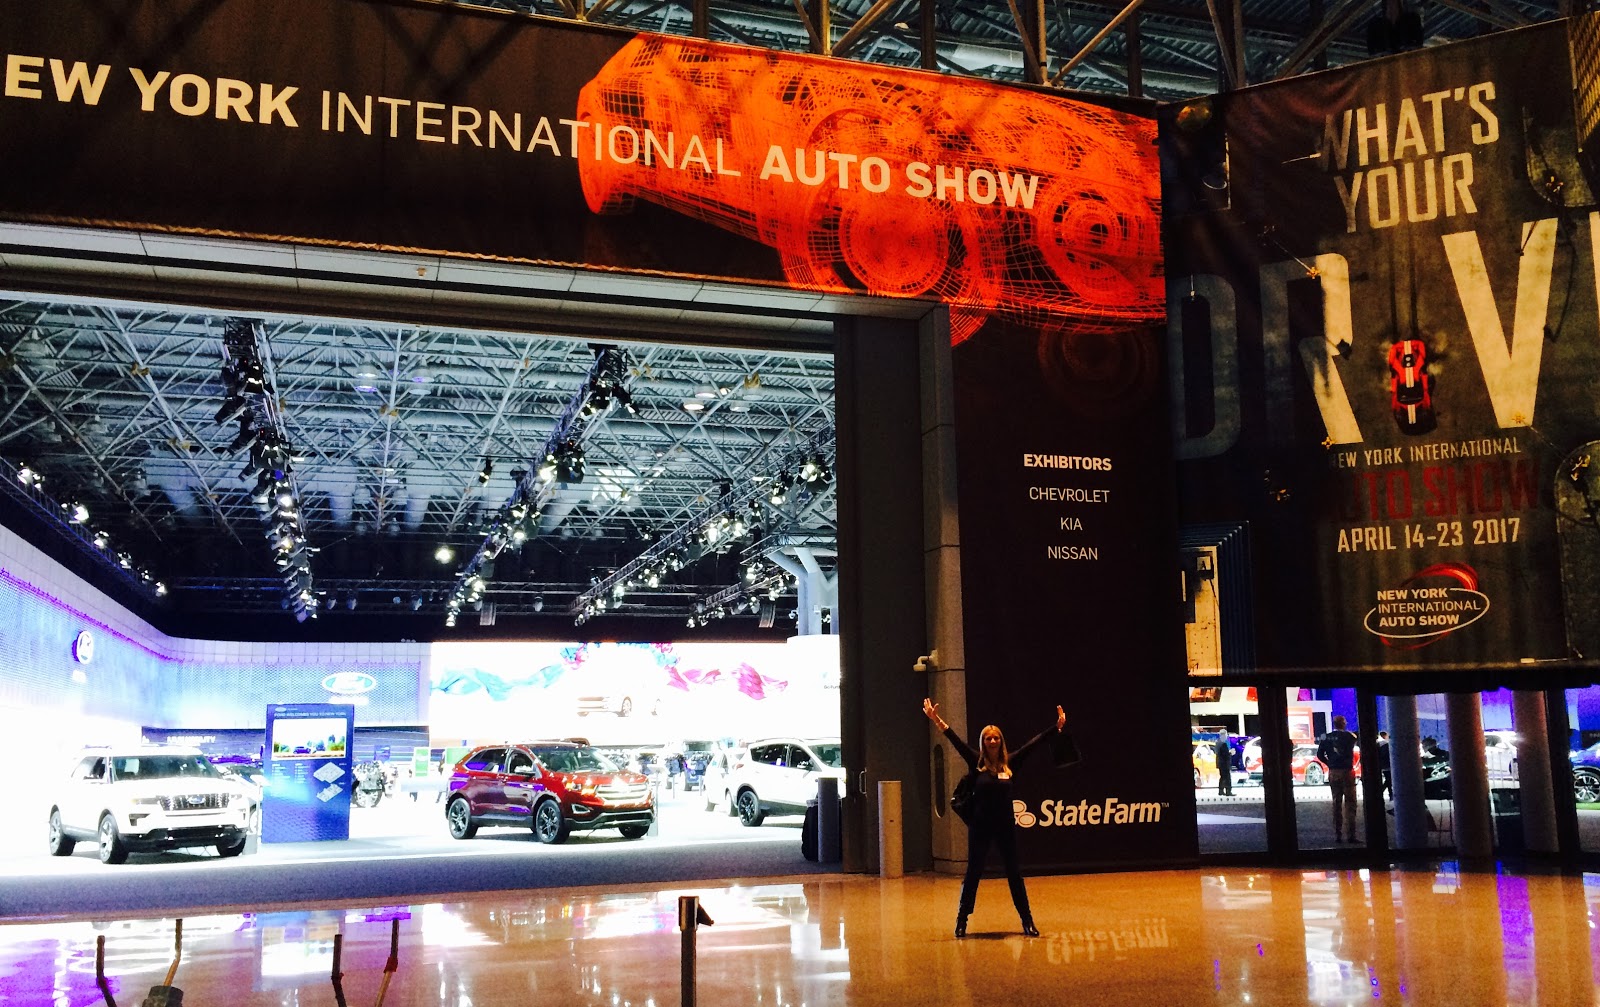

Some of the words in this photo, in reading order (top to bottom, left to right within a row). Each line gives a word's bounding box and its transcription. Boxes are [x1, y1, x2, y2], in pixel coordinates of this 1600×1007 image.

[128, 67, 299, 128] YORK
[321, 90, 741, 178] INTERNATIONAL
[760, 145, 891, 193] AUTO
[905, 162, 1039, 209] SHOW
[1333, 151, 1478, 234] YOUR
[1364, 447, 1403, 467] YORK
[1410, 437, 1521, 462] INTERNATIONAL
[1023, 453, 1112, 471] EXHIBITORS
[1029, 486, 1110, 503] CHEVROLET
[1423, 459, 1540, 517] SHOW
[1060, 516, 1083, 531] KIA
[1337, 526, 1397, 553] APRIL
[1404, 522, 1464, 549] 14-23
[1473, 517, 1521, 545] 2017
[1047, 545, 1098, 561] NISSAN
[1377, 589, 1408, 600] NEW
[1411, 588, 1448, 599] YORK
[1378, 600, 1481, 614] INTERNATIONAL
[1379, 616, 1415, 627] AUTO
[1419, 614, 1460, 626] SHOW
